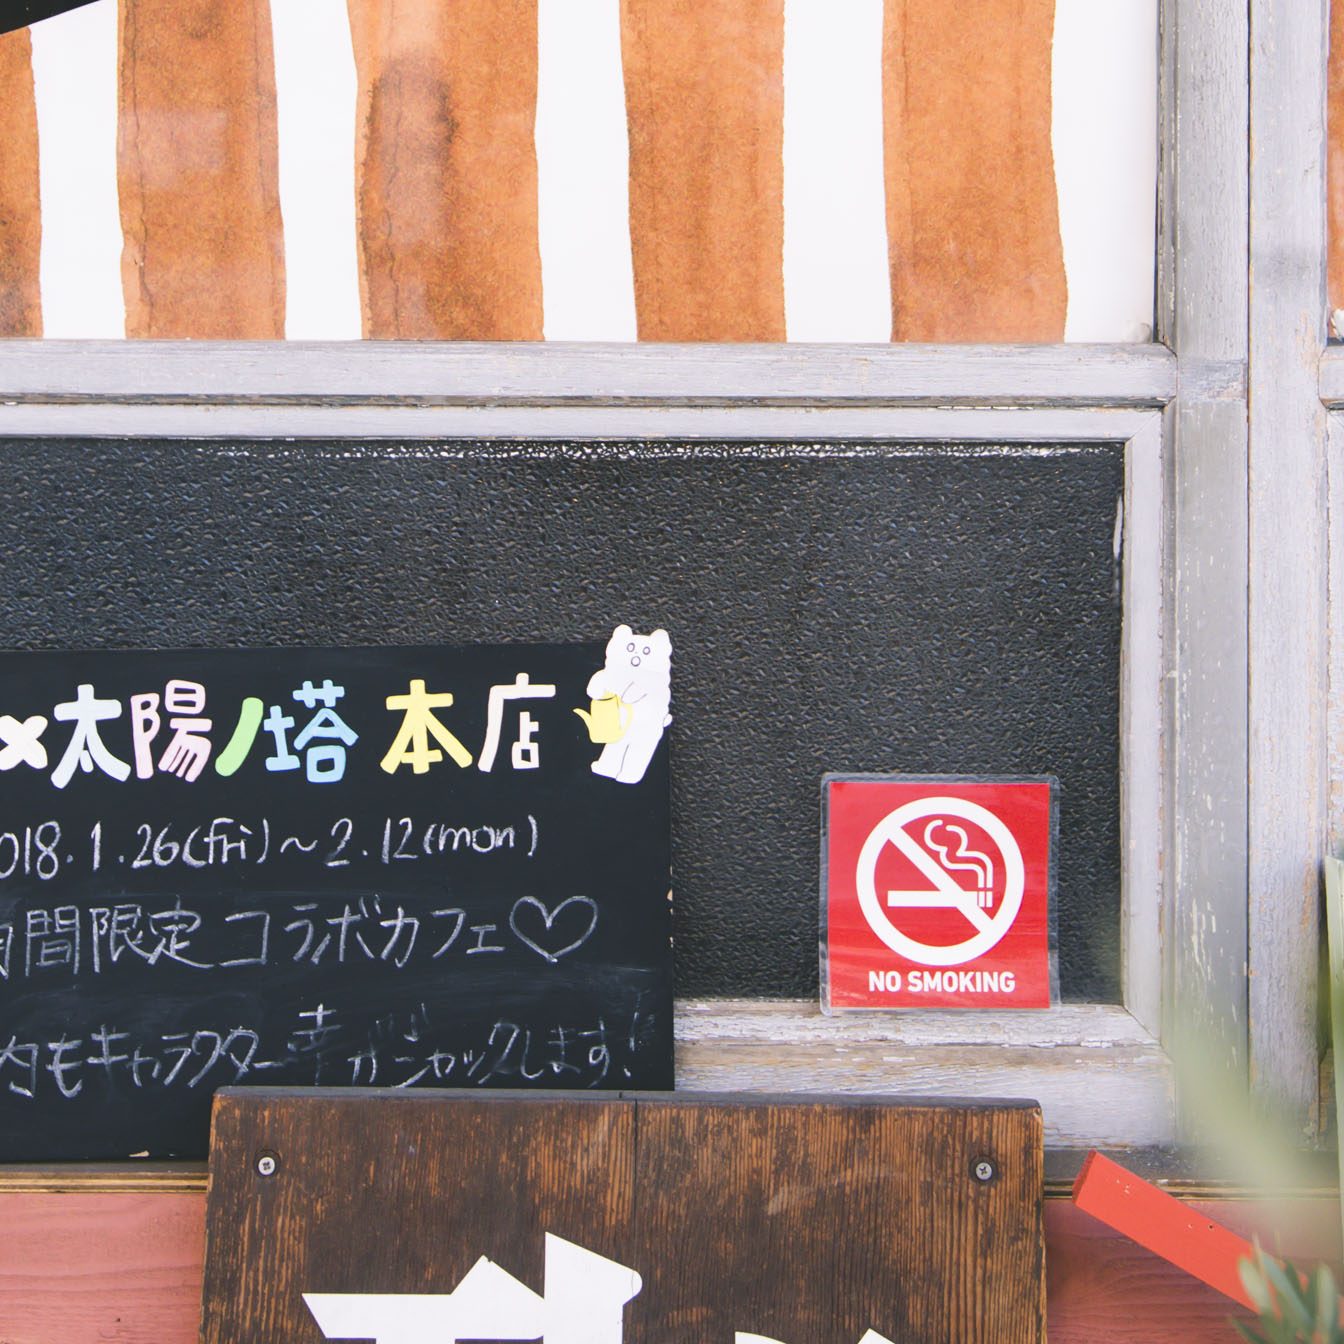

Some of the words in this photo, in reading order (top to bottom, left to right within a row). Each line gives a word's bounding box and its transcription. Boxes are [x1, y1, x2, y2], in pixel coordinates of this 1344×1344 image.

[379, 677, 556, 777] 本店
[868, 970, 902, 992] NO
[907, 970, 1016, 993] SMOKING
